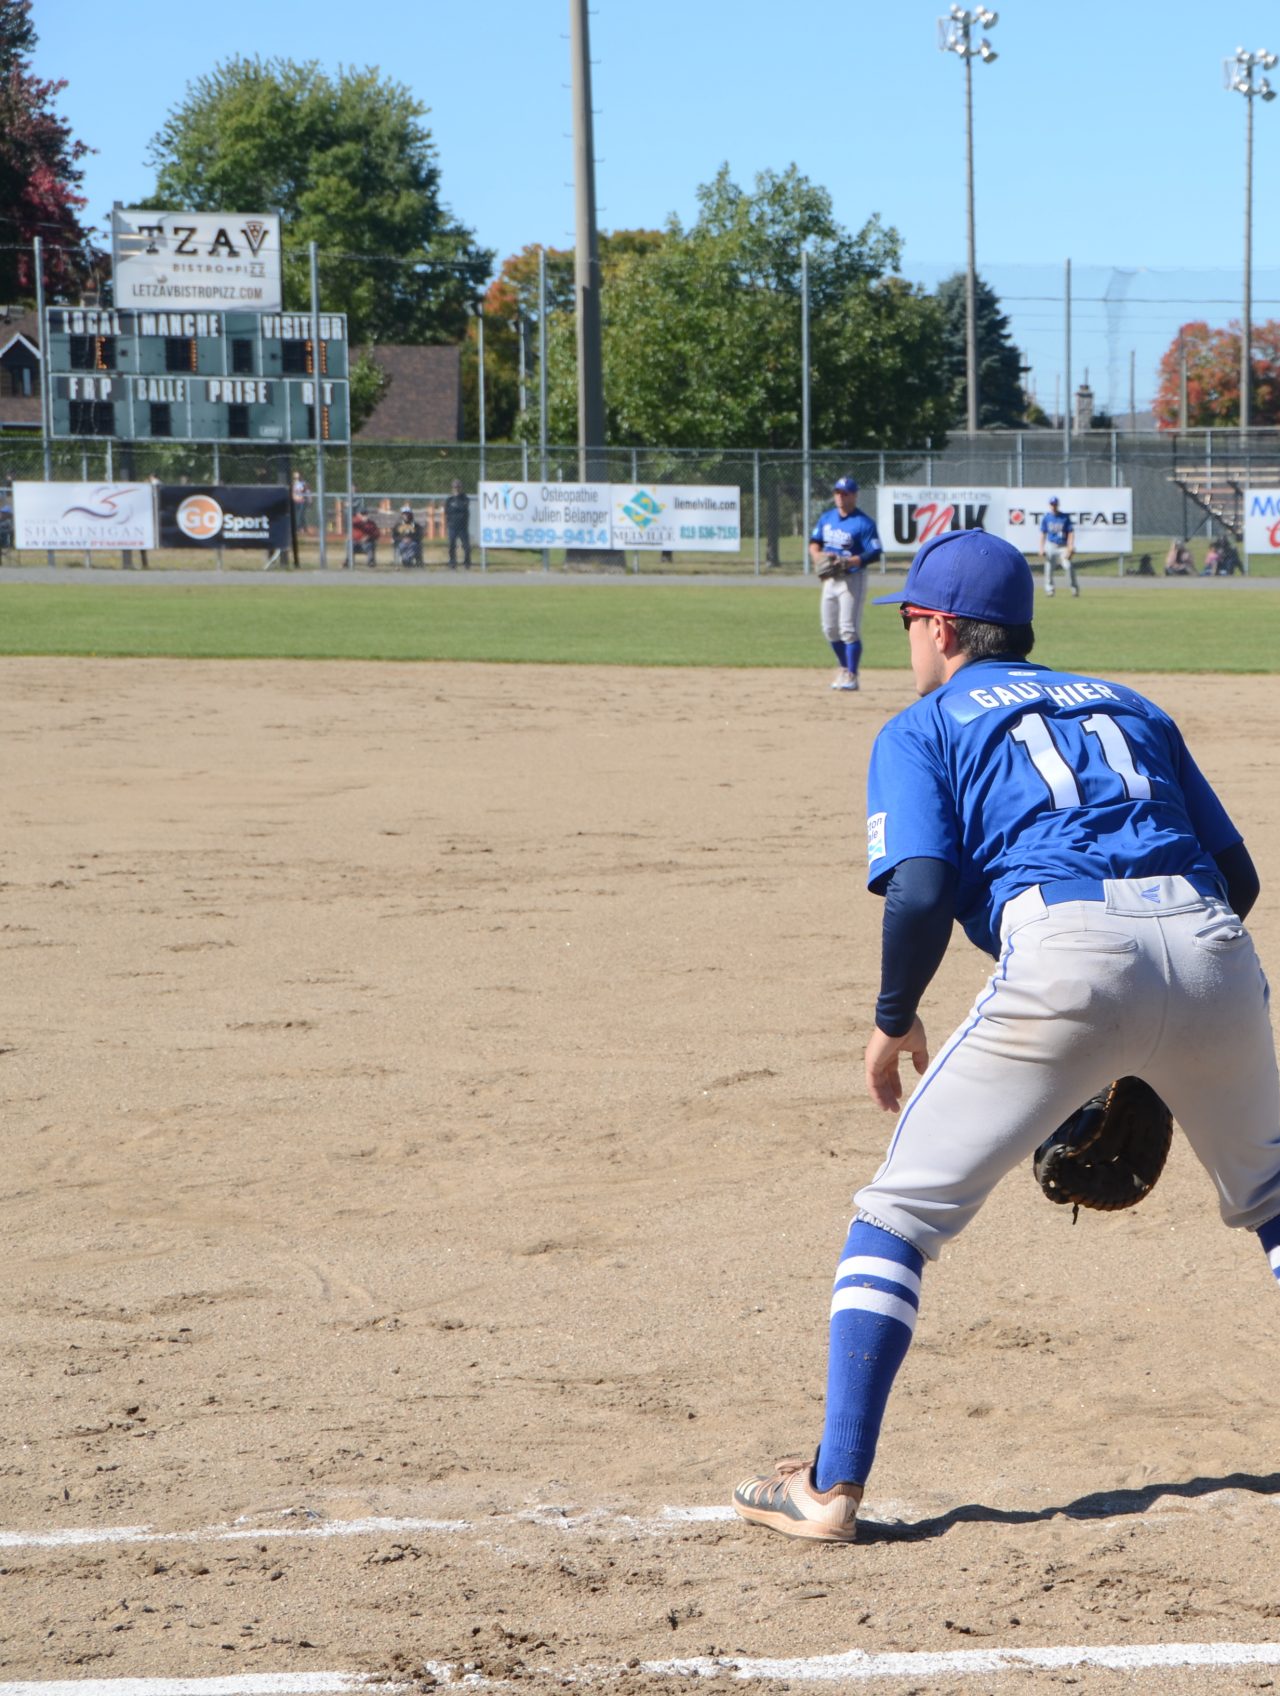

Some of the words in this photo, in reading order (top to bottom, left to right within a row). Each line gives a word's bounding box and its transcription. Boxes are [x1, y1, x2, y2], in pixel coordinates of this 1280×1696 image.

[132, 284, 263, 300] LETZAVBISTROPIZZ.COM
[63, 311, 121, 335] LOCAL
[142, 314, 218, 337] MANCHE
[263, 316, 344, 340] VISITUR
[138, 380, 184, 402] BALLE
[209, 381, 267, 404] PRISE
[541, 486, 599, 504] Ostéopathie
[223, 514, 270, 532] Sport
[532, 507, 562, 524] Julien
[565, 507, 608, 528] Bélanger
[1030, 512, 1127, 525] TFAB
[24, 526, 145, 537] SHAWINIGAN
[482, 528, 608, 545] 819-699-9414
[1009, 712, 1152, 810] 11
